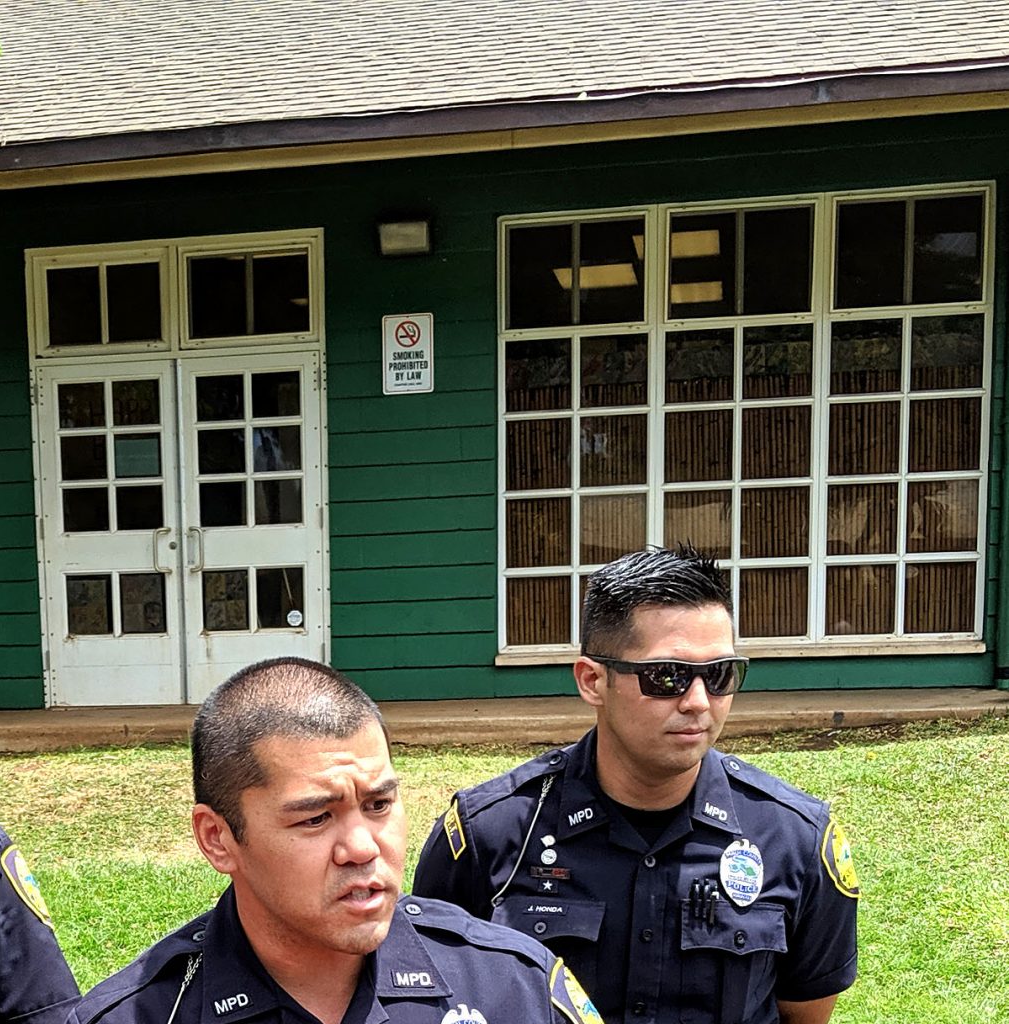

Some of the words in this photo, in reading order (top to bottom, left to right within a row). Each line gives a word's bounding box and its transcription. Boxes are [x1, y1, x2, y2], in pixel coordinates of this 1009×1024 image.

[392, 350, 424, 361] SMOKING
[389, 361, 428, 371] PROHIBITED
[395, 372, 404, 381] BY
[406, 371, 422, 380] LAW
[568, 807, 594, 826] MPD
[704, 802, 728, 821] MPD
[535, 905, 563, 913] HONDA
[395, 971, 432, 986] MPD
[214, 993, 249, 1014] MPD
